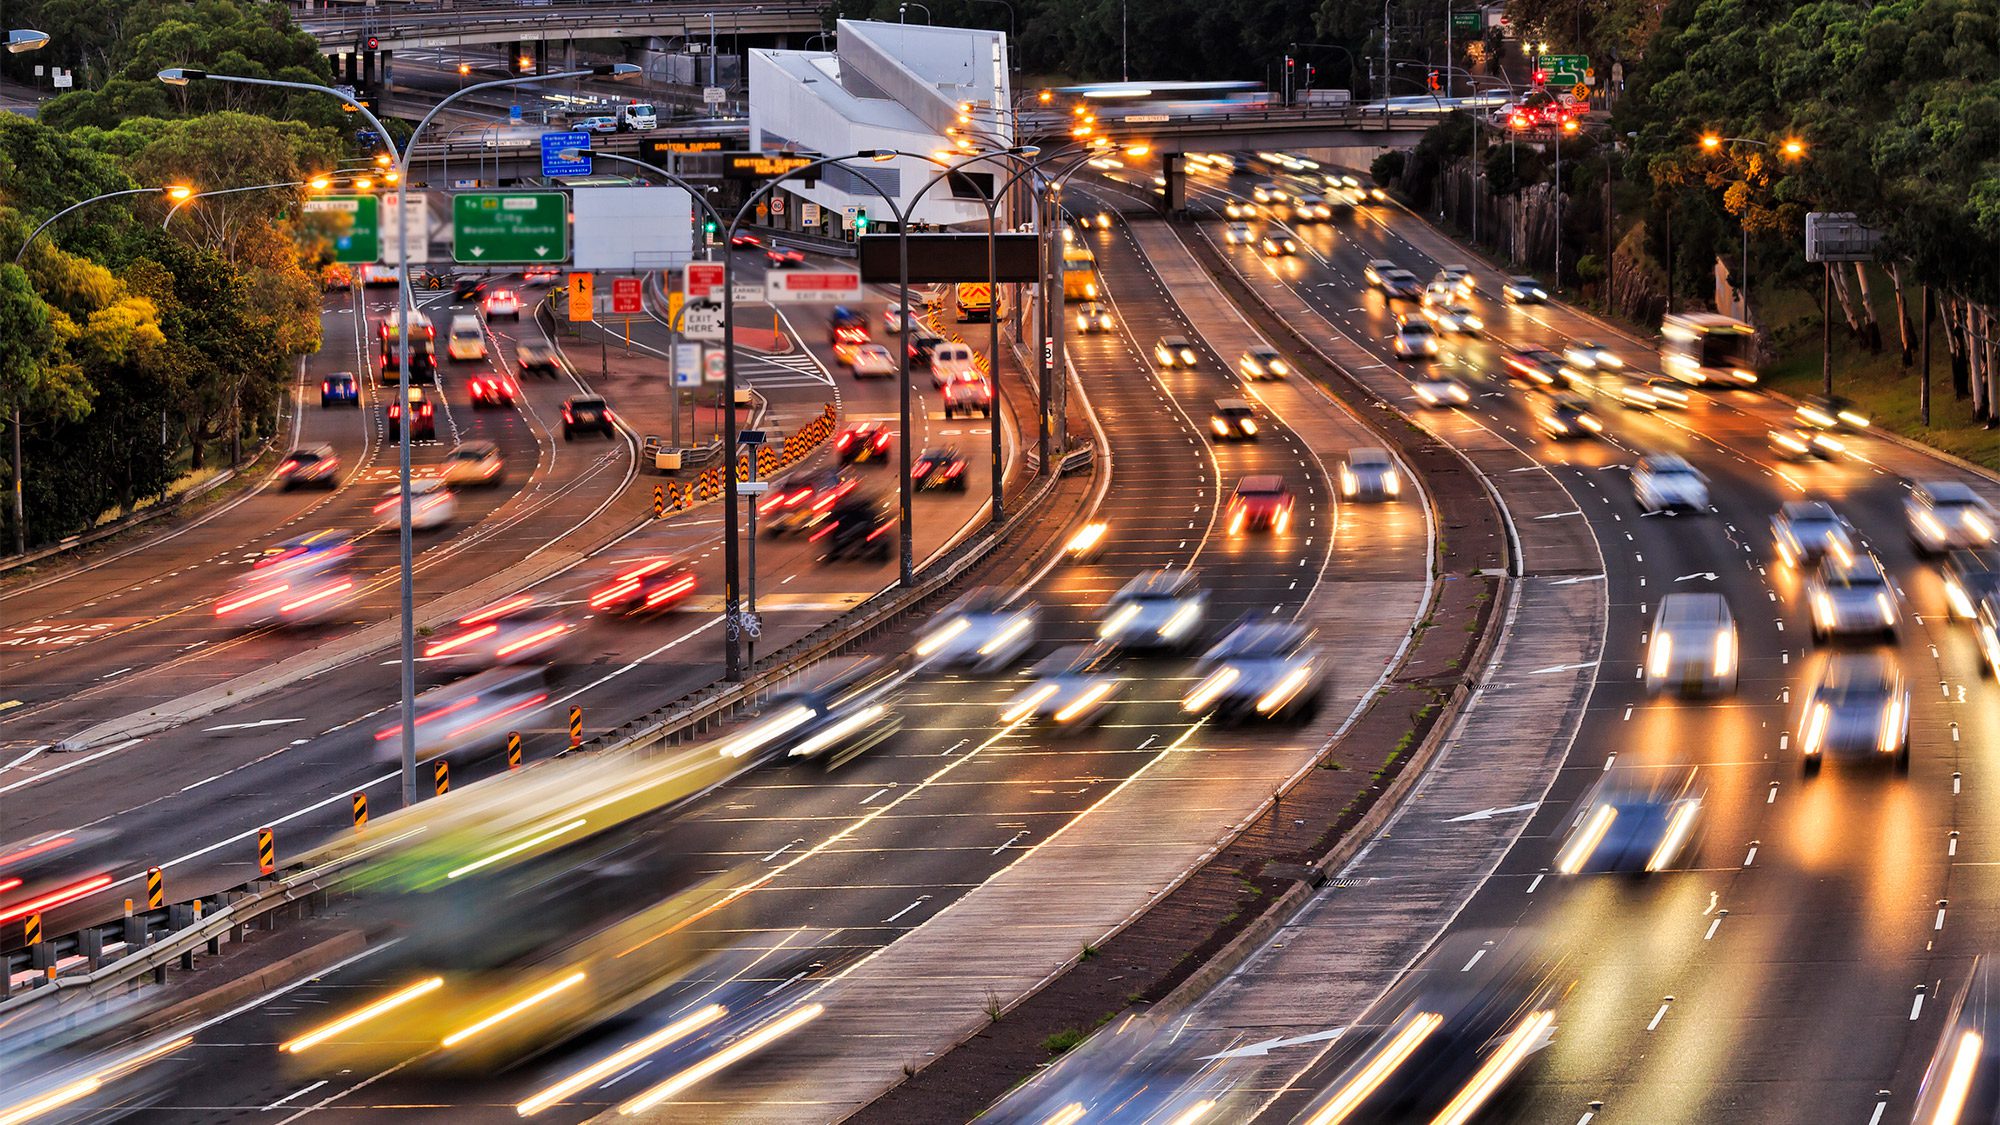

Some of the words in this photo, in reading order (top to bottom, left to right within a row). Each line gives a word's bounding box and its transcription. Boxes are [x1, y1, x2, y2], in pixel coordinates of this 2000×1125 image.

[654, 143, 686, 151] EASTERN
[689, 142, 721, 150] SUBURBS
[734, 158, 770, 167] EASTERN
[774, 158, 811, 167] SUBURBS
[465, 200, 477, 208] To
[495, 212, 523, 224] City
[689, 315, 712, 323] EXIT
[14, 623, 115, 634] BUS
[0, 635, 91, 646] ANE
